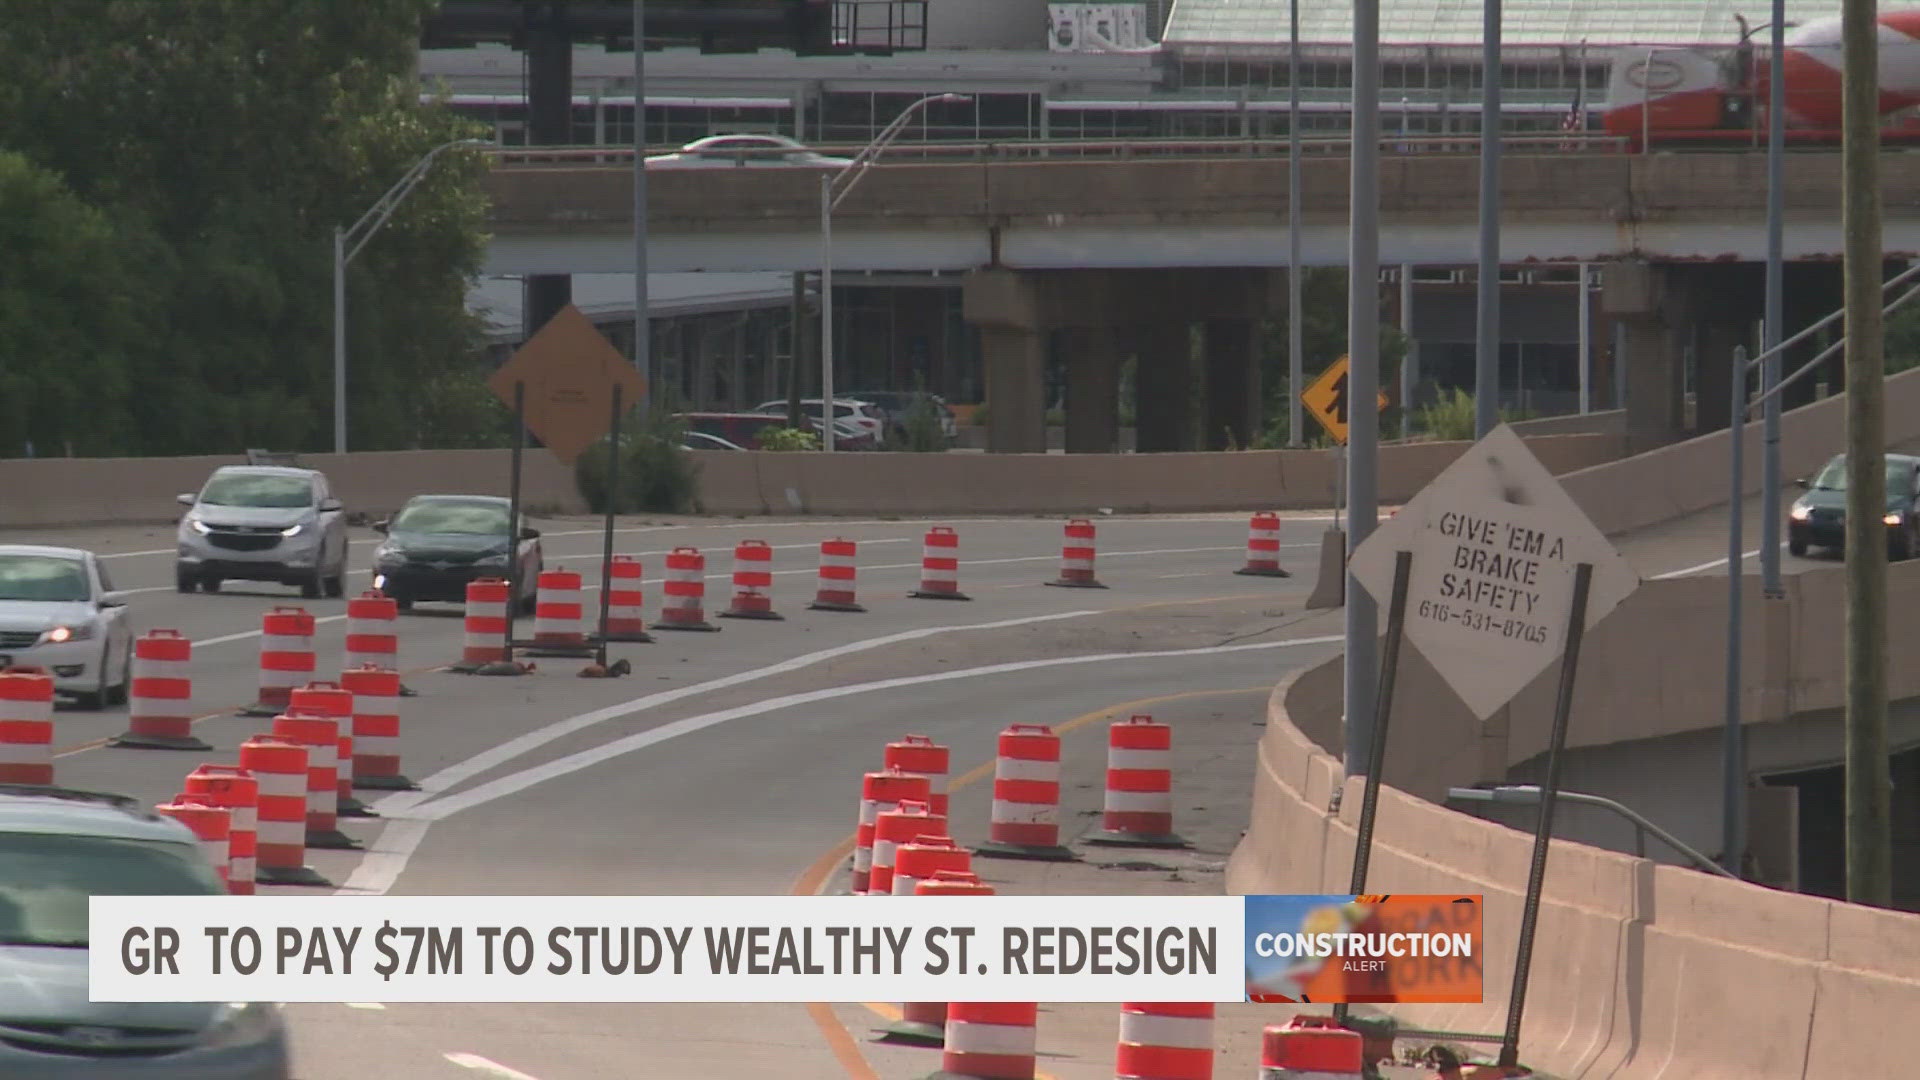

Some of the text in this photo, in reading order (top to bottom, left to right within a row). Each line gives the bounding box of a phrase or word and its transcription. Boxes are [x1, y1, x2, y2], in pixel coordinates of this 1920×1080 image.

[1440, 512, 1564, 560] GIVE 'EM A
[1454, 546, 1539, 585] BRAKE
[1440, 573, 1539, 615] SAFETY
[1419, 600, 1547, 643] 616-531-8705
